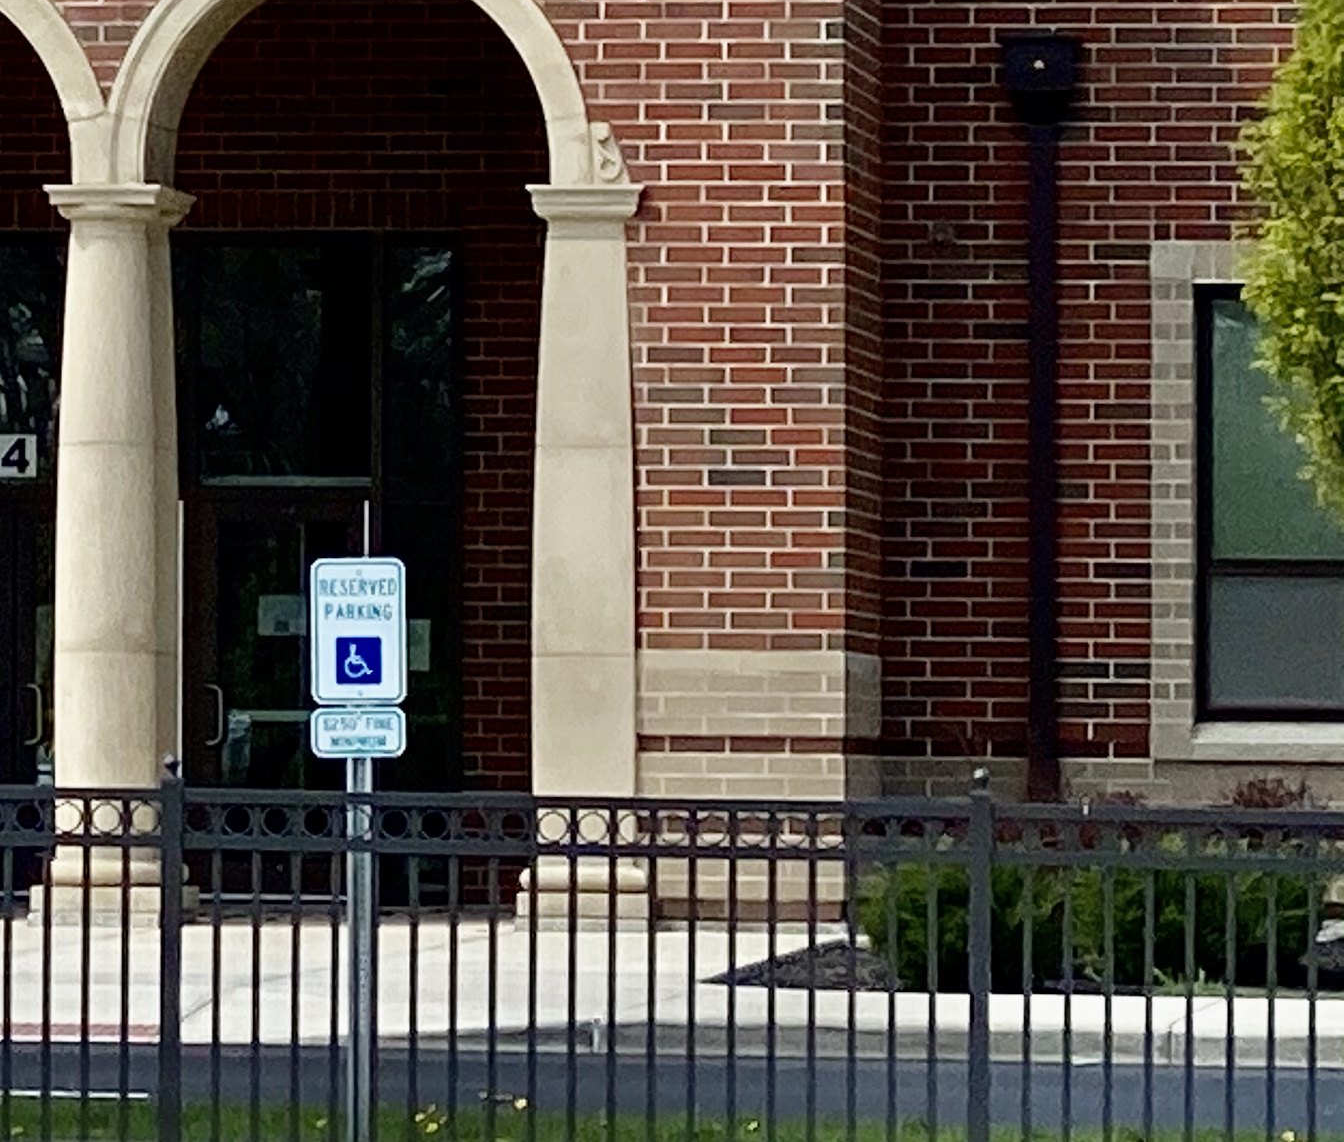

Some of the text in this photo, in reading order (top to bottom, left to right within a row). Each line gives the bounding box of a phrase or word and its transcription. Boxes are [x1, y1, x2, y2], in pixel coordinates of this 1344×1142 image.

[1, 438, 29, 473] 4
[319, 578, 397, 596] RESERVED
[324, 603, 392, 620] PARKING
